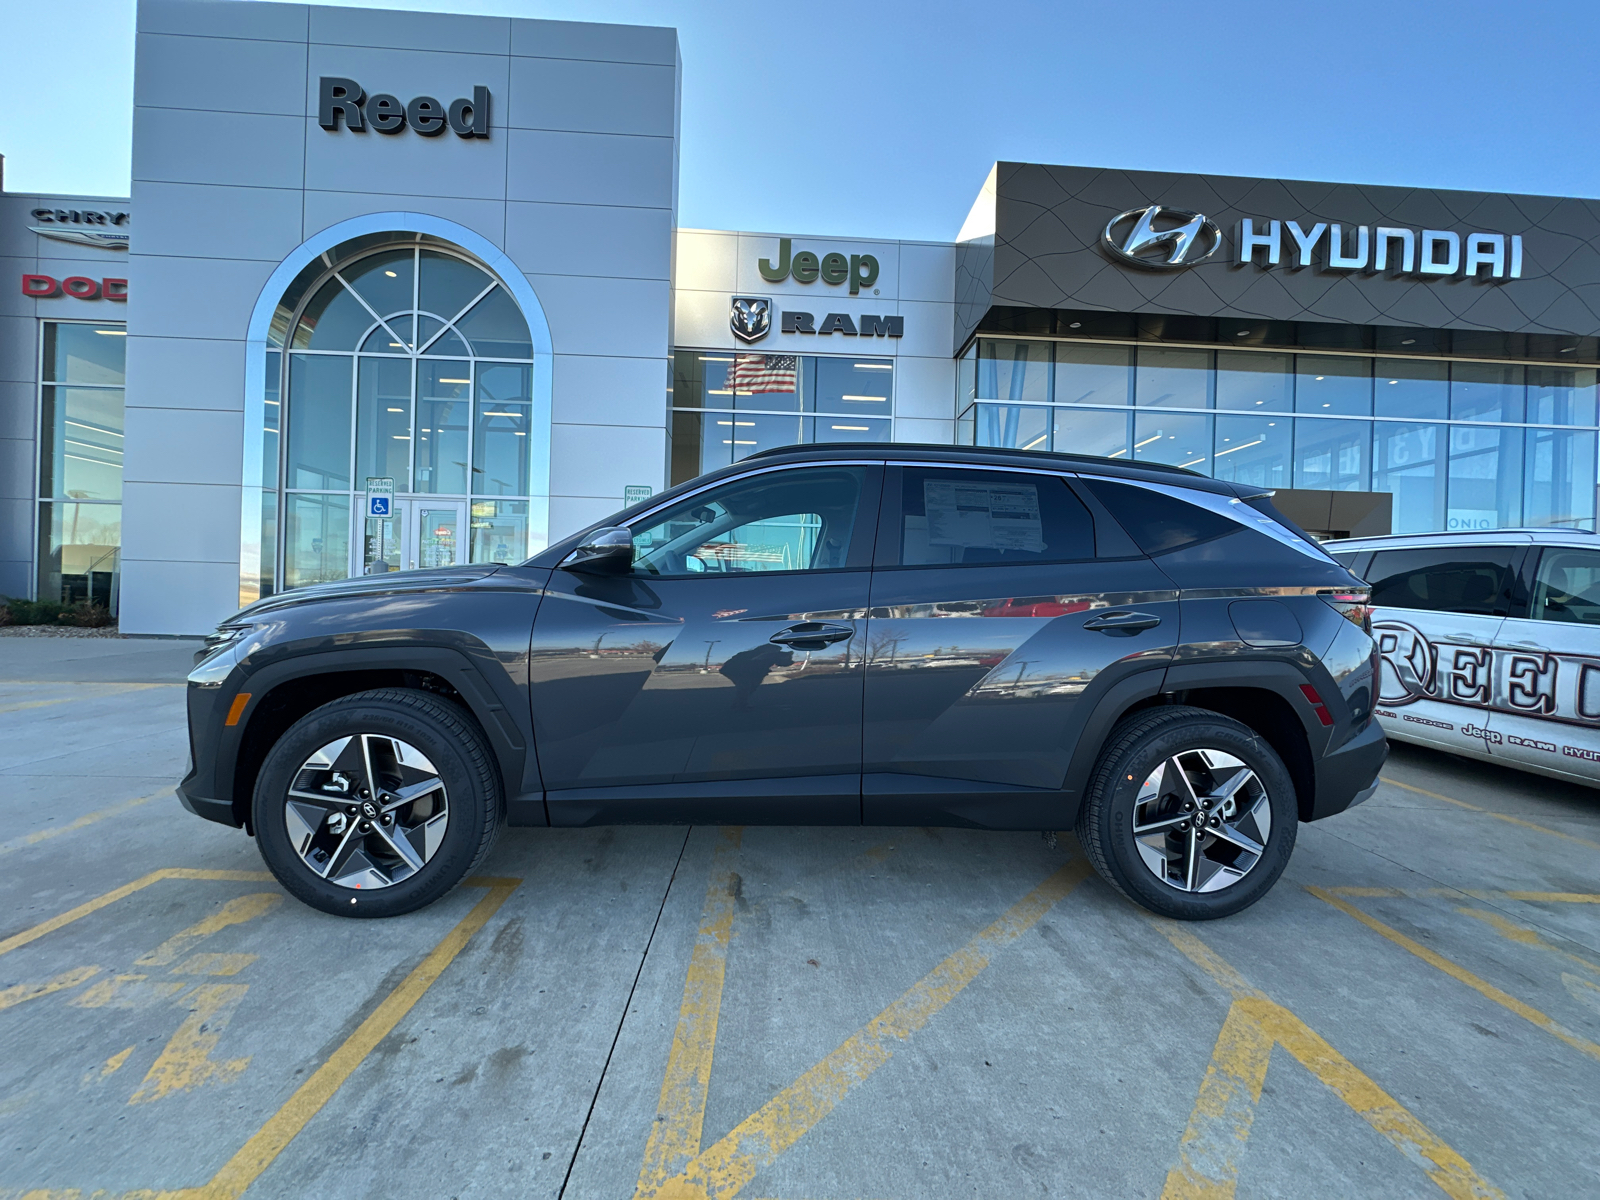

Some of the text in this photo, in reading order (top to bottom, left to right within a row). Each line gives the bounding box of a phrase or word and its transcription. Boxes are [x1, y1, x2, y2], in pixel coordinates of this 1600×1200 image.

[318, 76, 491, 139] Reed
[31, 207, 130, 226] CHRY
[758, 238, 880, 295] Jeep
[1236, 217, 1523, 280] HYUNDAI
[781, 310, 905, 339] RAM
[1403, 714, 1454, 730] DODGE
[1461, 723, 1503, 745] Jeep
[1508, 735, 1556, 753] RAM
